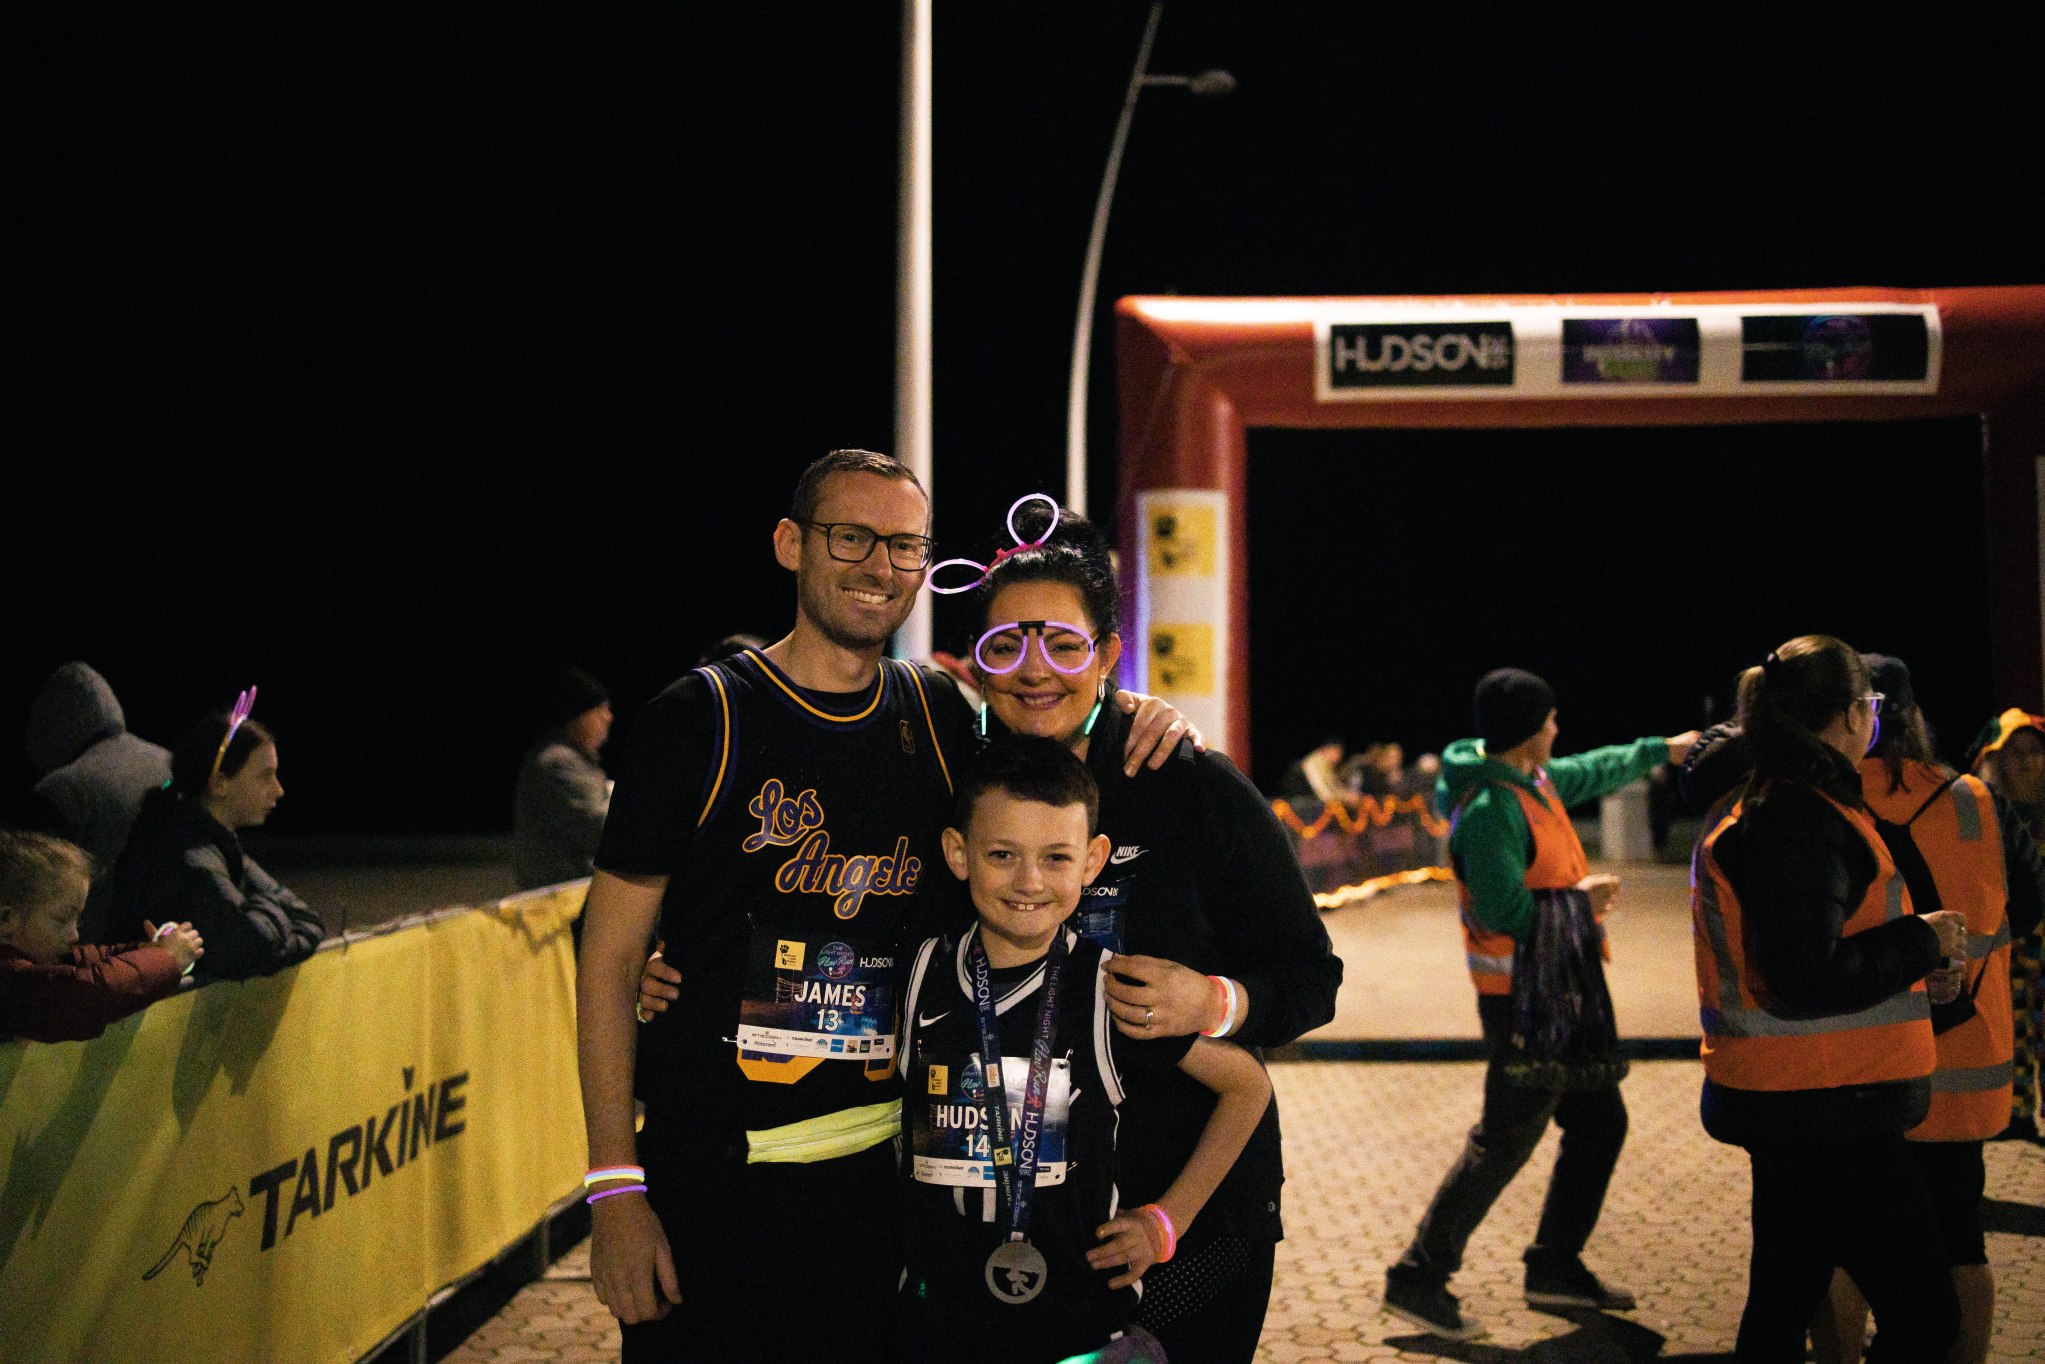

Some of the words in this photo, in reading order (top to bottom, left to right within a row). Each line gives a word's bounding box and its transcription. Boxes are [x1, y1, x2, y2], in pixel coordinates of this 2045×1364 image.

[1335, 333, 1490, 373] HUDSON
[742, 778, 824, 853] Los
[1116, 846, 1140, 857] NIKE
[775, 830, 922, 920] Angele
[1081, 887, 1113, 896] DSON
[976, 957, 991, 1006] HUDSON
[1050, 965, 1060, 981] THE
[794, 981, 867, 1007] JAMES
[1045, 982, 1057, 1009] LIGHT
[817, 1009, 839, 1031] 13
[1041, 1010, 1052, 1039] NIGHT
[936, 1104, 1023, 1131] HUDSN
[966, 1134, 990, 1158] 14
[1020, 1112, 1039, 1169] HUDSON
[250, 1066, 470, 1252] TARKINE
